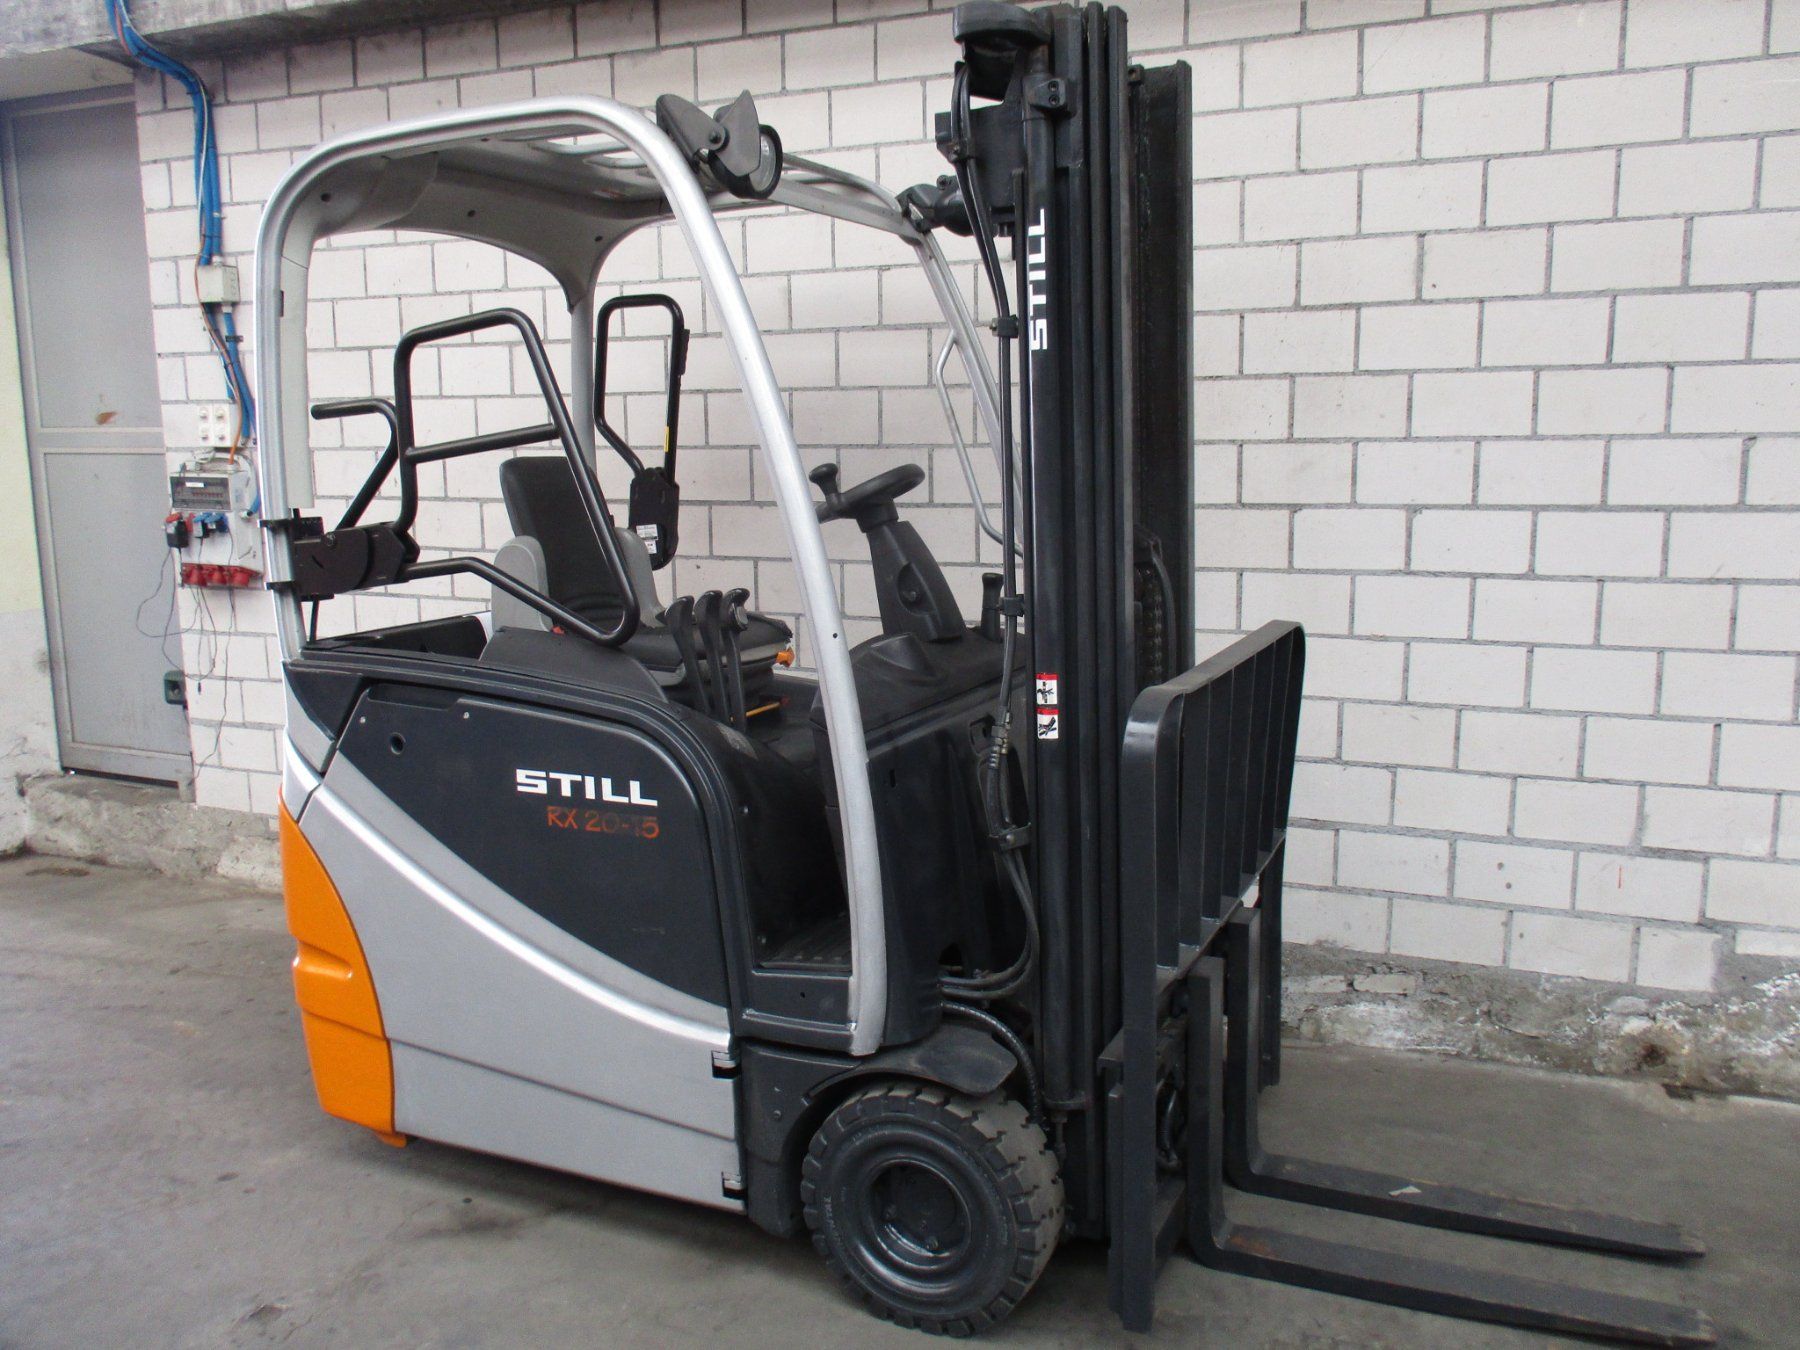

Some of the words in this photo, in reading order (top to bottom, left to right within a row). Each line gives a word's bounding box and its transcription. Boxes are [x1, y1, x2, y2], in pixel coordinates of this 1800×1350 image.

[1028, 208, 1047, 349] STILL
[516, 769, 658, 807] STILL
[547, 806, 579, 830] RX
